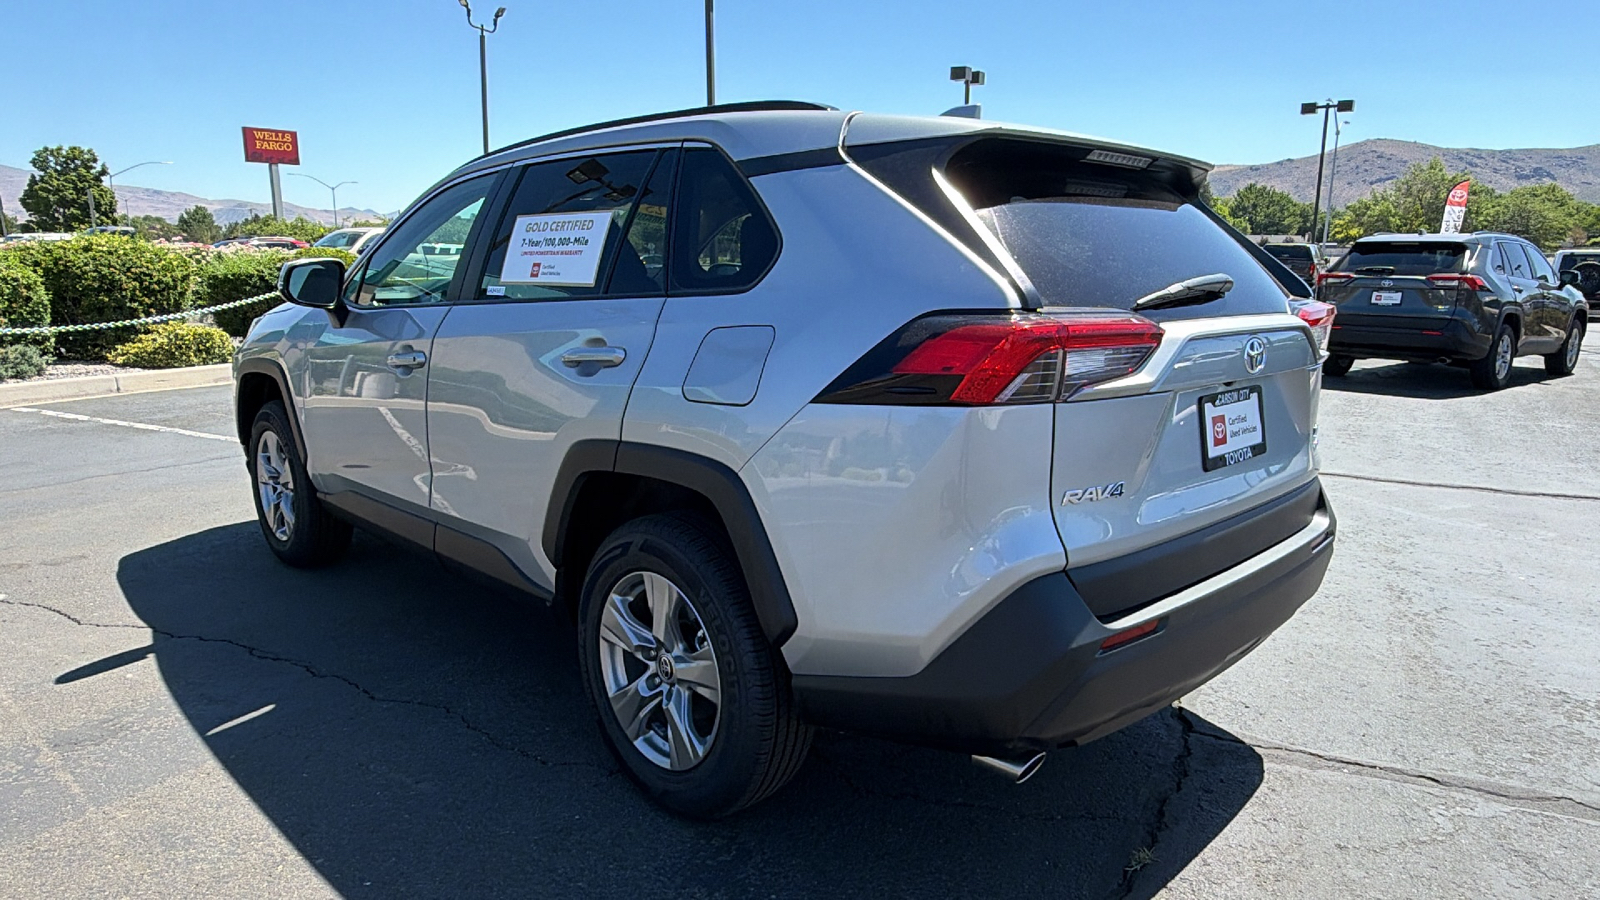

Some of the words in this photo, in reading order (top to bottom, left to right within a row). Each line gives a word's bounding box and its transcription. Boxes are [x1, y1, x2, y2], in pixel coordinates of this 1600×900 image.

[253, 130, 292, 142] WELLS
[255, 140, 293, 151] FARGO
[525, 221, 549, 233] GOLD
[549, 219, 594, 232] CERTIFIED
[520, 236, 589, 248] 7-Year/100,000-Mile
[1215, 391, 1238, 406] CARSON
[1239, 388, 1250, 401] CITY
[1228, 413, 1247, 426] Certified
[1229, 428, 1241, 439] Used
[1240, 425, 1258, 437] Vehicles
[1225, 446, 1253, 466] TOYOTA
[1061, 481, 1125, 506] RAV4
